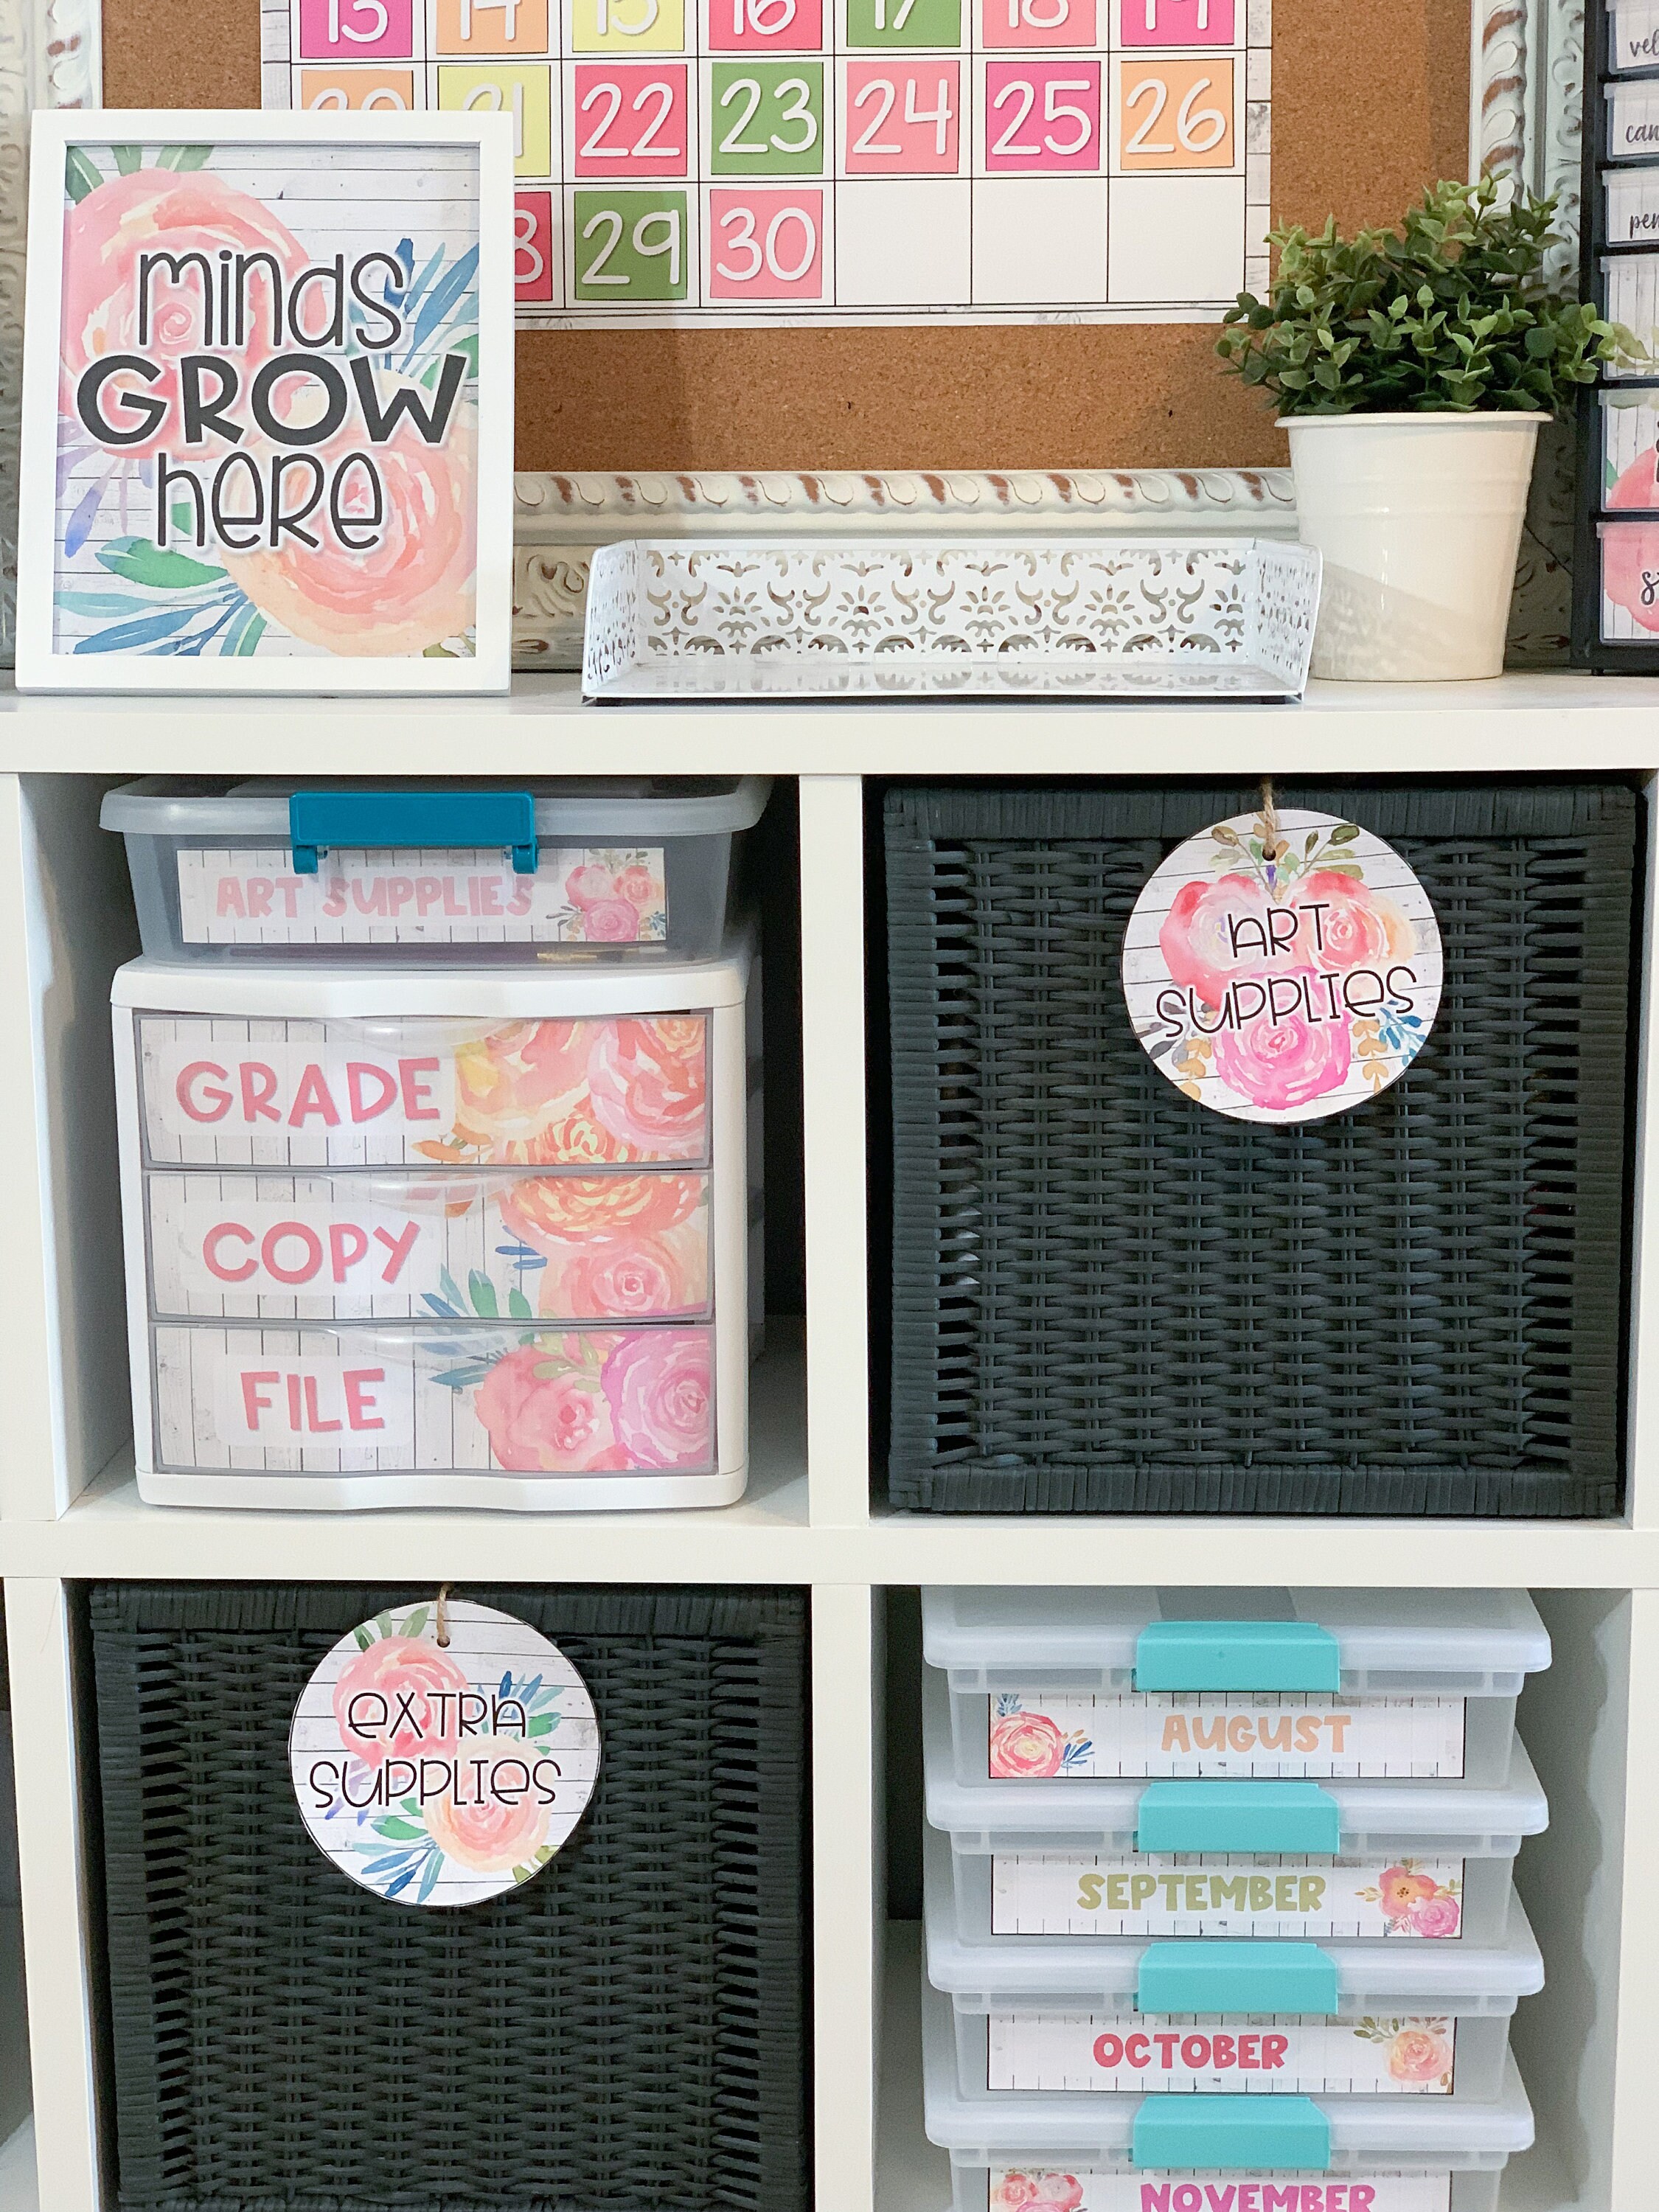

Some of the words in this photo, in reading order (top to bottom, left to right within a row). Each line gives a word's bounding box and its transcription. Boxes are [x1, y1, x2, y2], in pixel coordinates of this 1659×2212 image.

[580, 82, 681, 157] 22
[720, 78, 818, 154] 23
[851, 78, 953, 155] 24
[991, 80, 1092, 155] 25
[1125, 78, 1227, 153] 26
[581, 209, 680, 285] 29
[716, 207, 816, 282] 30
[138, 250, 404, 349] minds
[77, 353, 467, 446] GROW
[216, 876, 303, 919] ART
[321, 875, 533, 918] SUPPLIES
[1227, 903, 1330, 959] ART
[175, 1057, 441, 1128] GRADE
[203, 1220, 421, 1284] COPY
[240, 1368, 386, 1432] FILE
[1161, 1714, 1352, 1753] AUGUST
[1077, 1873, 1327, 1912] SEPTEMBER
[1093, 2033, 1290, 2070] OCTOBER
[1140, 2183, 1377, 2212] NOVEMBER
